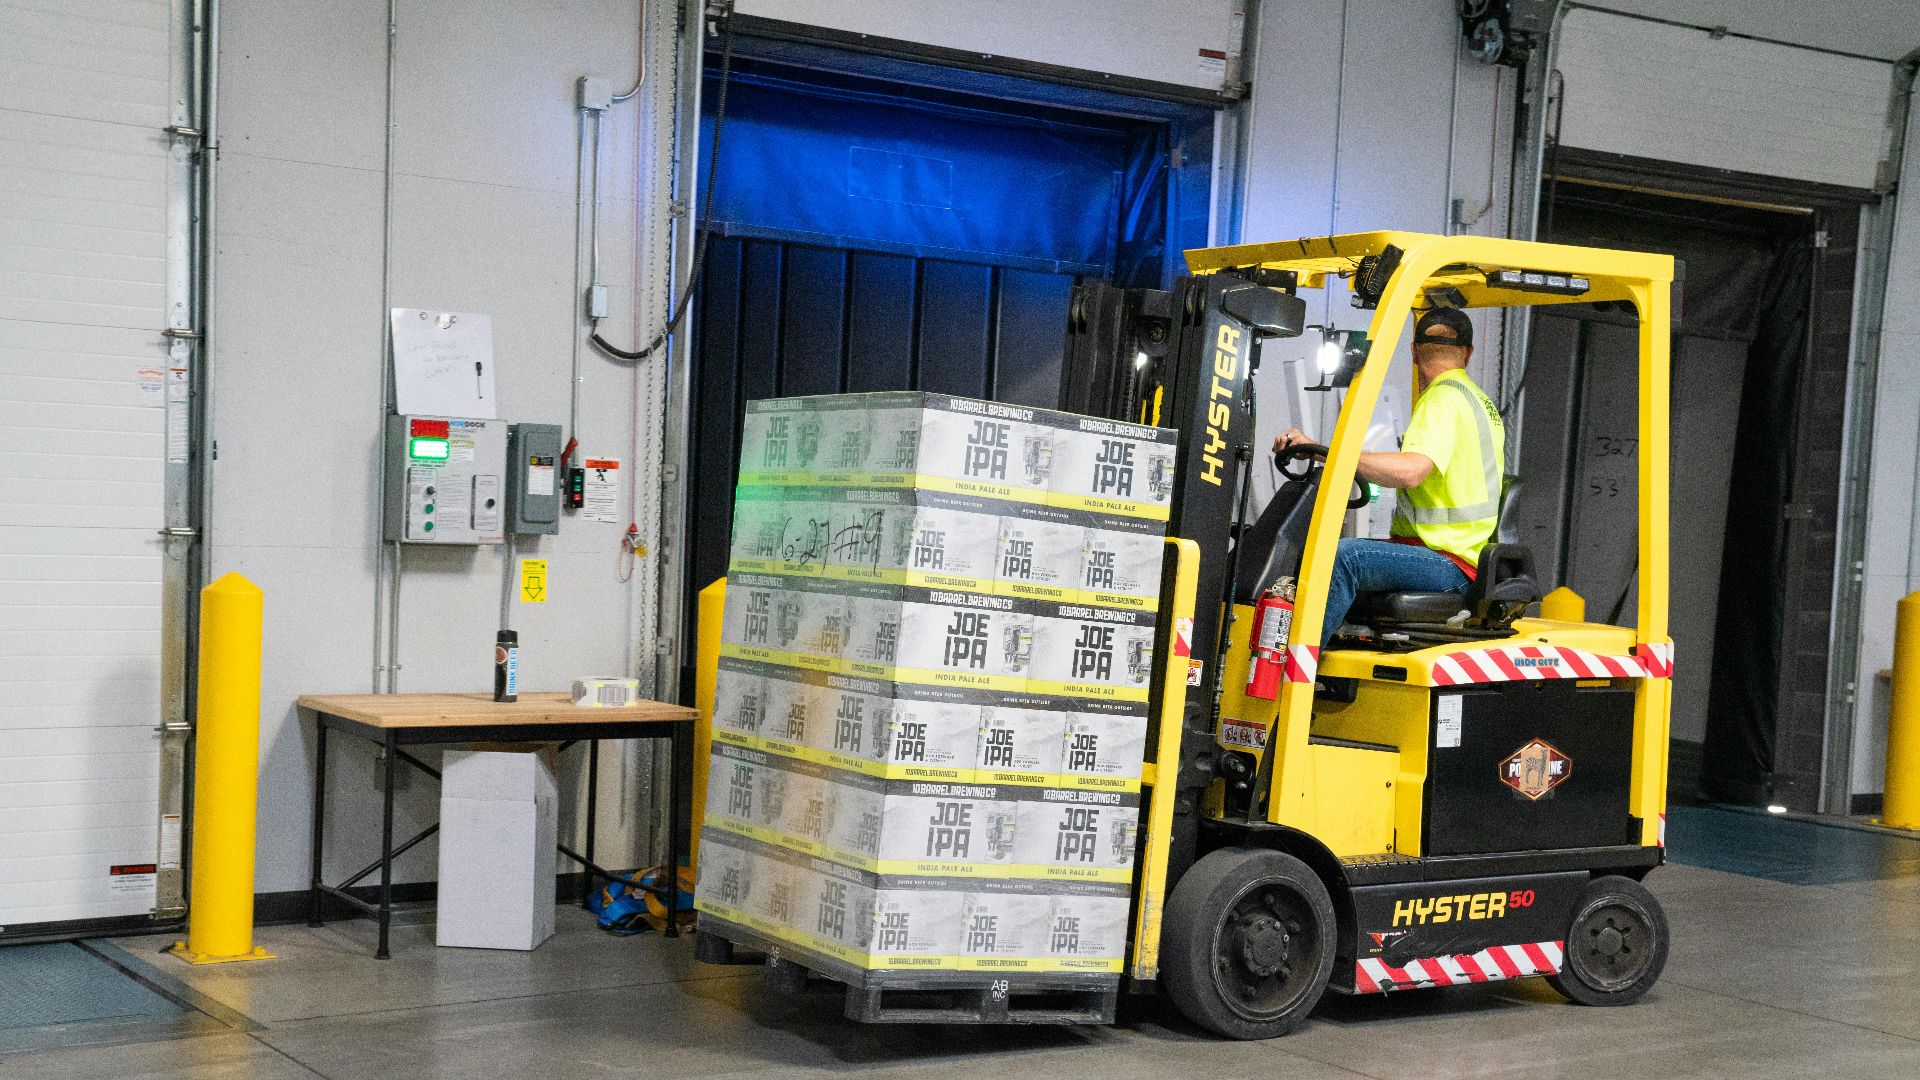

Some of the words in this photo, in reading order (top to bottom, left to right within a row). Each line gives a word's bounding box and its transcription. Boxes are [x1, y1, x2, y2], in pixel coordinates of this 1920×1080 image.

[1201, 324, 1240, 486] HYSTER
[968, 420, 1010, 448] JOE
[964, 446, 1007, 480] IPA
[1096, 440, 1136, 467] JOE
[956, 482, 976, 492] INDIA
[978, 484, 996, 494] PALE
[998, 488, 1011, 496] ALE
[1092, 464, 1133, 497] IPA
[1084, 499, 1103, 508] INDIA
[1105, 502, 1122, 511] PALE
[1124, 504, 1136, 512] ALE
[916, 530, 945, 548] JOE
[1005, 540, 1033, 558] JOE
[914, 547, 944, 569] IPA
[1003, 556, 1031, 579] IPA
[1088, 551, 1115, 568] JOE
[1086, 567, 1113, 588] IPA
[747, 591, 770, 614] JOE
[744, 614, 768, 643] IPA
[876, 622, 896, 639] JOE
[948, 612, 990, 637] JOE
[1075, 625, 1115, 650] JOE
[874, 639, 893, 661] IPA
[944, 636, 987, 669] IPA
[1071, 649, 1113, 680] IPA
[936, 674, 956, 682] INDIA
[1063, 685, 1082, 693] INDIA
[1084, 686, 1101, 694] PALE
[1102, 687, 1115, 695] ALE
[741, 694, 757, 711] JOE
[789, 704, 806, 720] JOE
[837, 695, 864, 721] JOE
[739, 710, 756, 731] IPA
[786, 718, 804, 741] IPA
[898, 723, 927, 740] JOE
[834, 720, 862, 752] IPA
[986, 728, 1014, 746] JOE
[1071, 733, 1098, 750] JOE
[894, 739, 925, 762] IPA
[983, 745, 1012, 767] IPA
[1068, 750, 1096, 771] IPA
[731, 764, 753, 789] JOE
[729, 787, 752, 818] IPA
[930, 802, 973, 826] JOE
[1059, 808, 1100, 832] JOE
[926, 827, 971, 858] IPA
[1055, 832, 1096, 862] IPA
[918, 864, 939, 872] INDIA
[941, 865, 959, 873] PALE
[821, 879, 847, 908] JOE
[1392, 892, 1507, 927] HYSTER
[1509, 889, 1534, 908] 50
[818, 903, 845, 940] IPA
[880, 912, 910, 928] JOE
[969, 915, 998, 932] JOE
[1053, 917, 1080, 933] JOE
[878, 930, 909, 951] IPA
[967, 932, 996, 952] IPA
[1050, 934, 1078, 953] IPA
[992, 991, 1006, 999] INC
